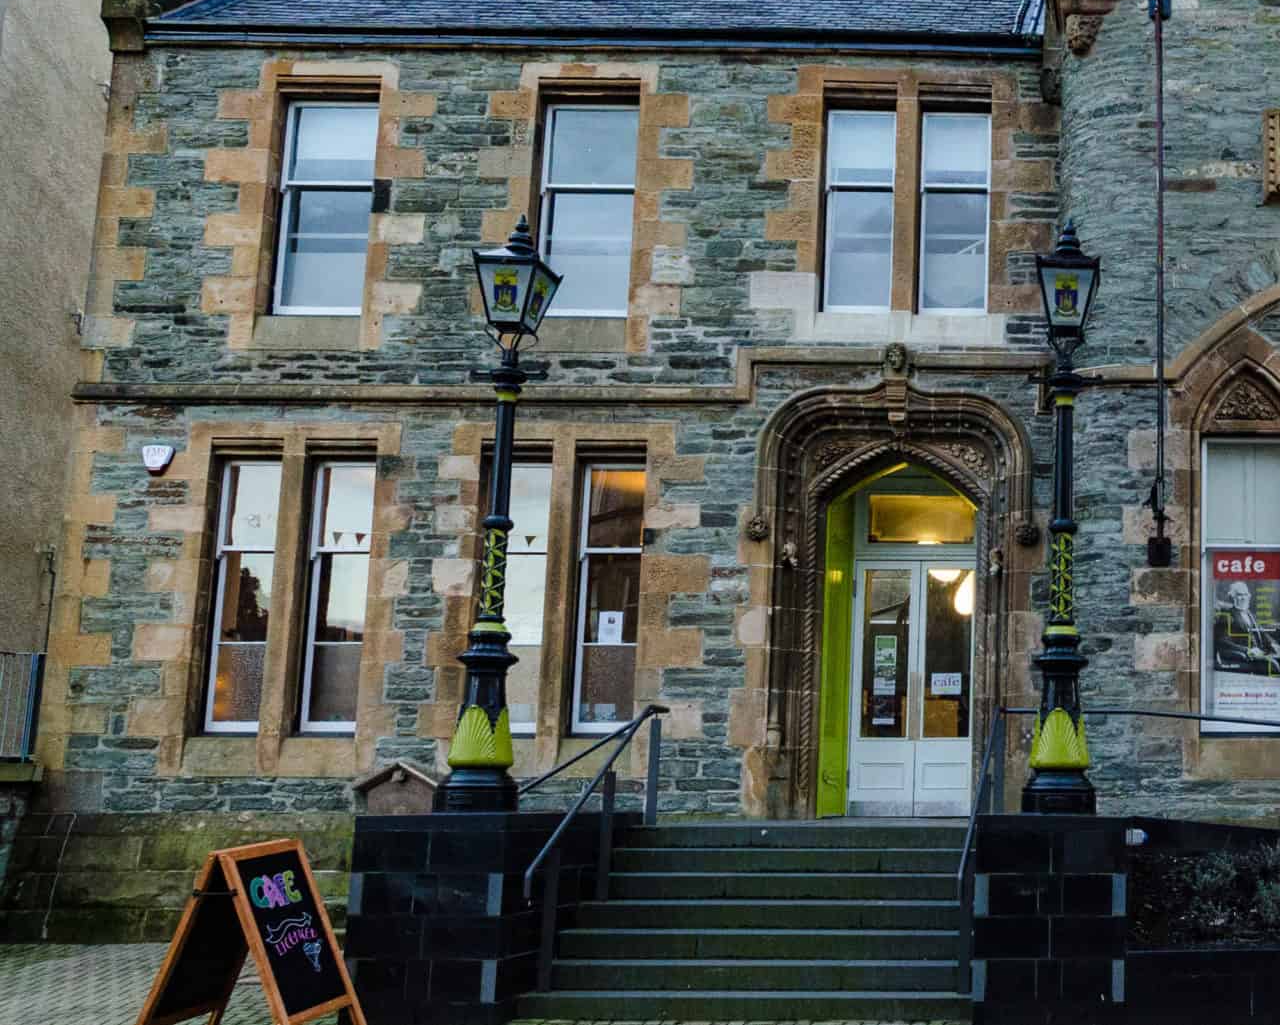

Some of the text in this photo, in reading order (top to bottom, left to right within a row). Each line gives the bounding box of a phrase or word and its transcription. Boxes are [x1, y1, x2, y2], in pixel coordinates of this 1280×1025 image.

[1217, 555, 1265, 573] cafe
[933, 677, 961, 688] cafe
[249, 869, 302, 909] CAFE
